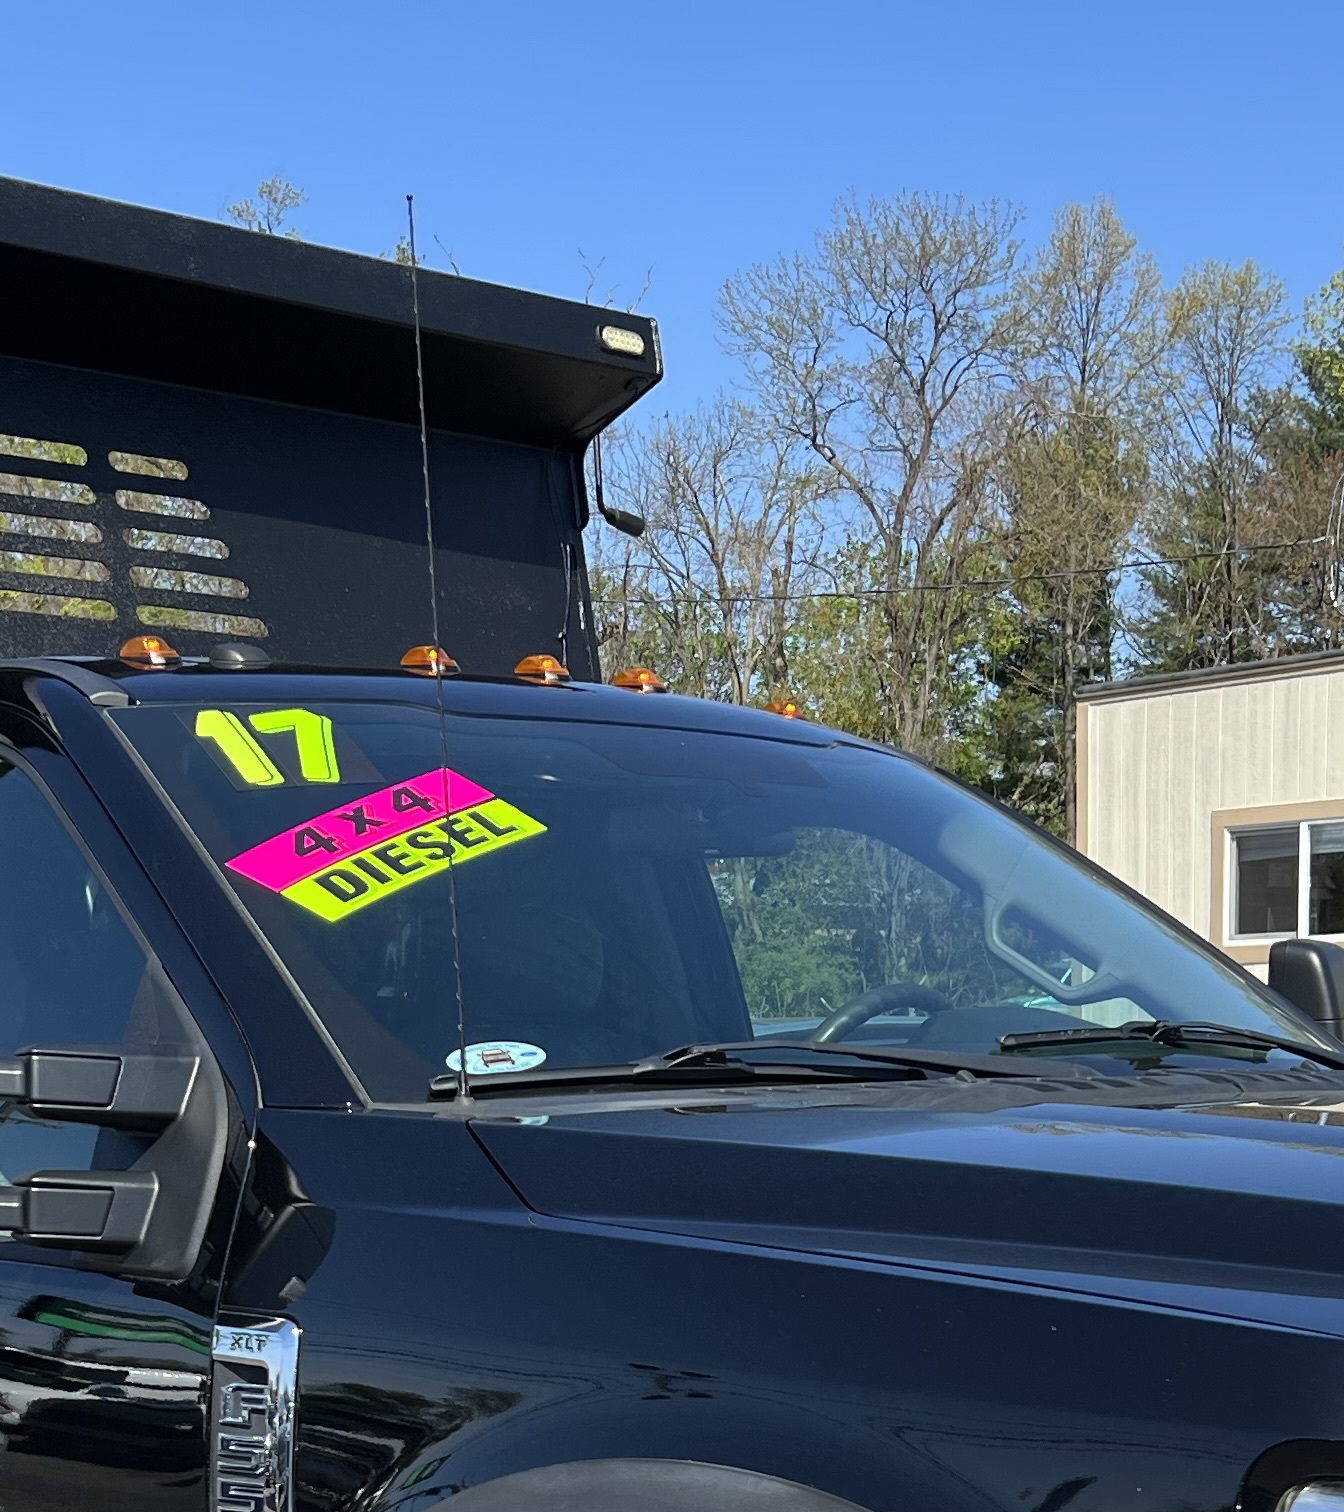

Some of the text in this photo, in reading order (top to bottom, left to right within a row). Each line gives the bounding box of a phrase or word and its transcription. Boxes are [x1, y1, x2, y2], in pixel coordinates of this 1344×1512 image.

[194, 708, 341, 786] 17
[315, 810, 518, 902] DIESEL
[229, 1333, 267, 1353] XLT
